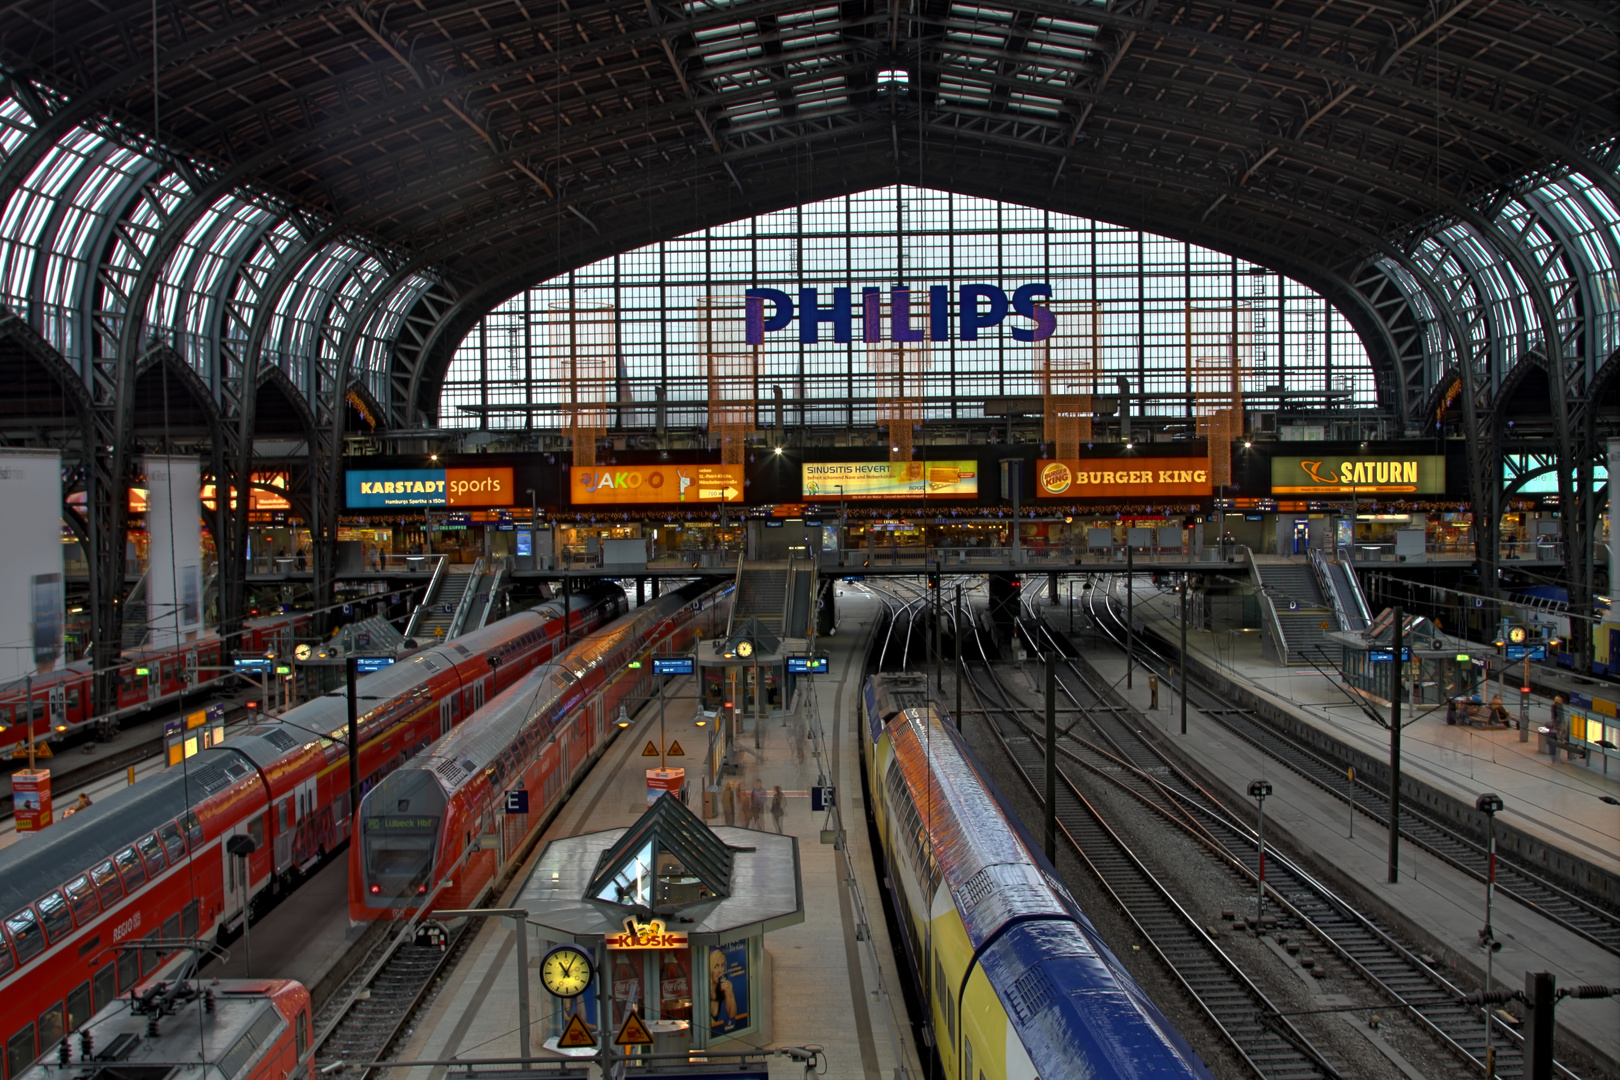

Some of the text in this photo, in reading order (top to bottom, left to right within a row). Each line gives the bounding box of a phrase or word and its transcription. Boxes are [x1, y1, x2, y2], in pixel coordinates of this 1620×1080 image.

[745, 283, 1057, 345] PHILIPS
[807, 465, 891, 474] SINUSITIS HEVERT
[1044, 468, 1068, 480] BURGER
[1340, 461, 1418, 483] SATURN
[1045, 473, 1069, 487] KING
[1076, 470, 1207, 484] BURGER KING
[360, 480, 445, 494] KARSTADT
[450, 476, 501, 496] sports
[343, 604, 350, 613] C
[1289, 601, 1297, 610] D
[1475, 598, 1482, 607] D
[508, 791, 519, 809] E
[821, 788, 833, 806] E
[417, 818, 432, 827] Hbf
[113, 917, 133, 943] REGIO
[618, 934, 675, 948] KIOSK
